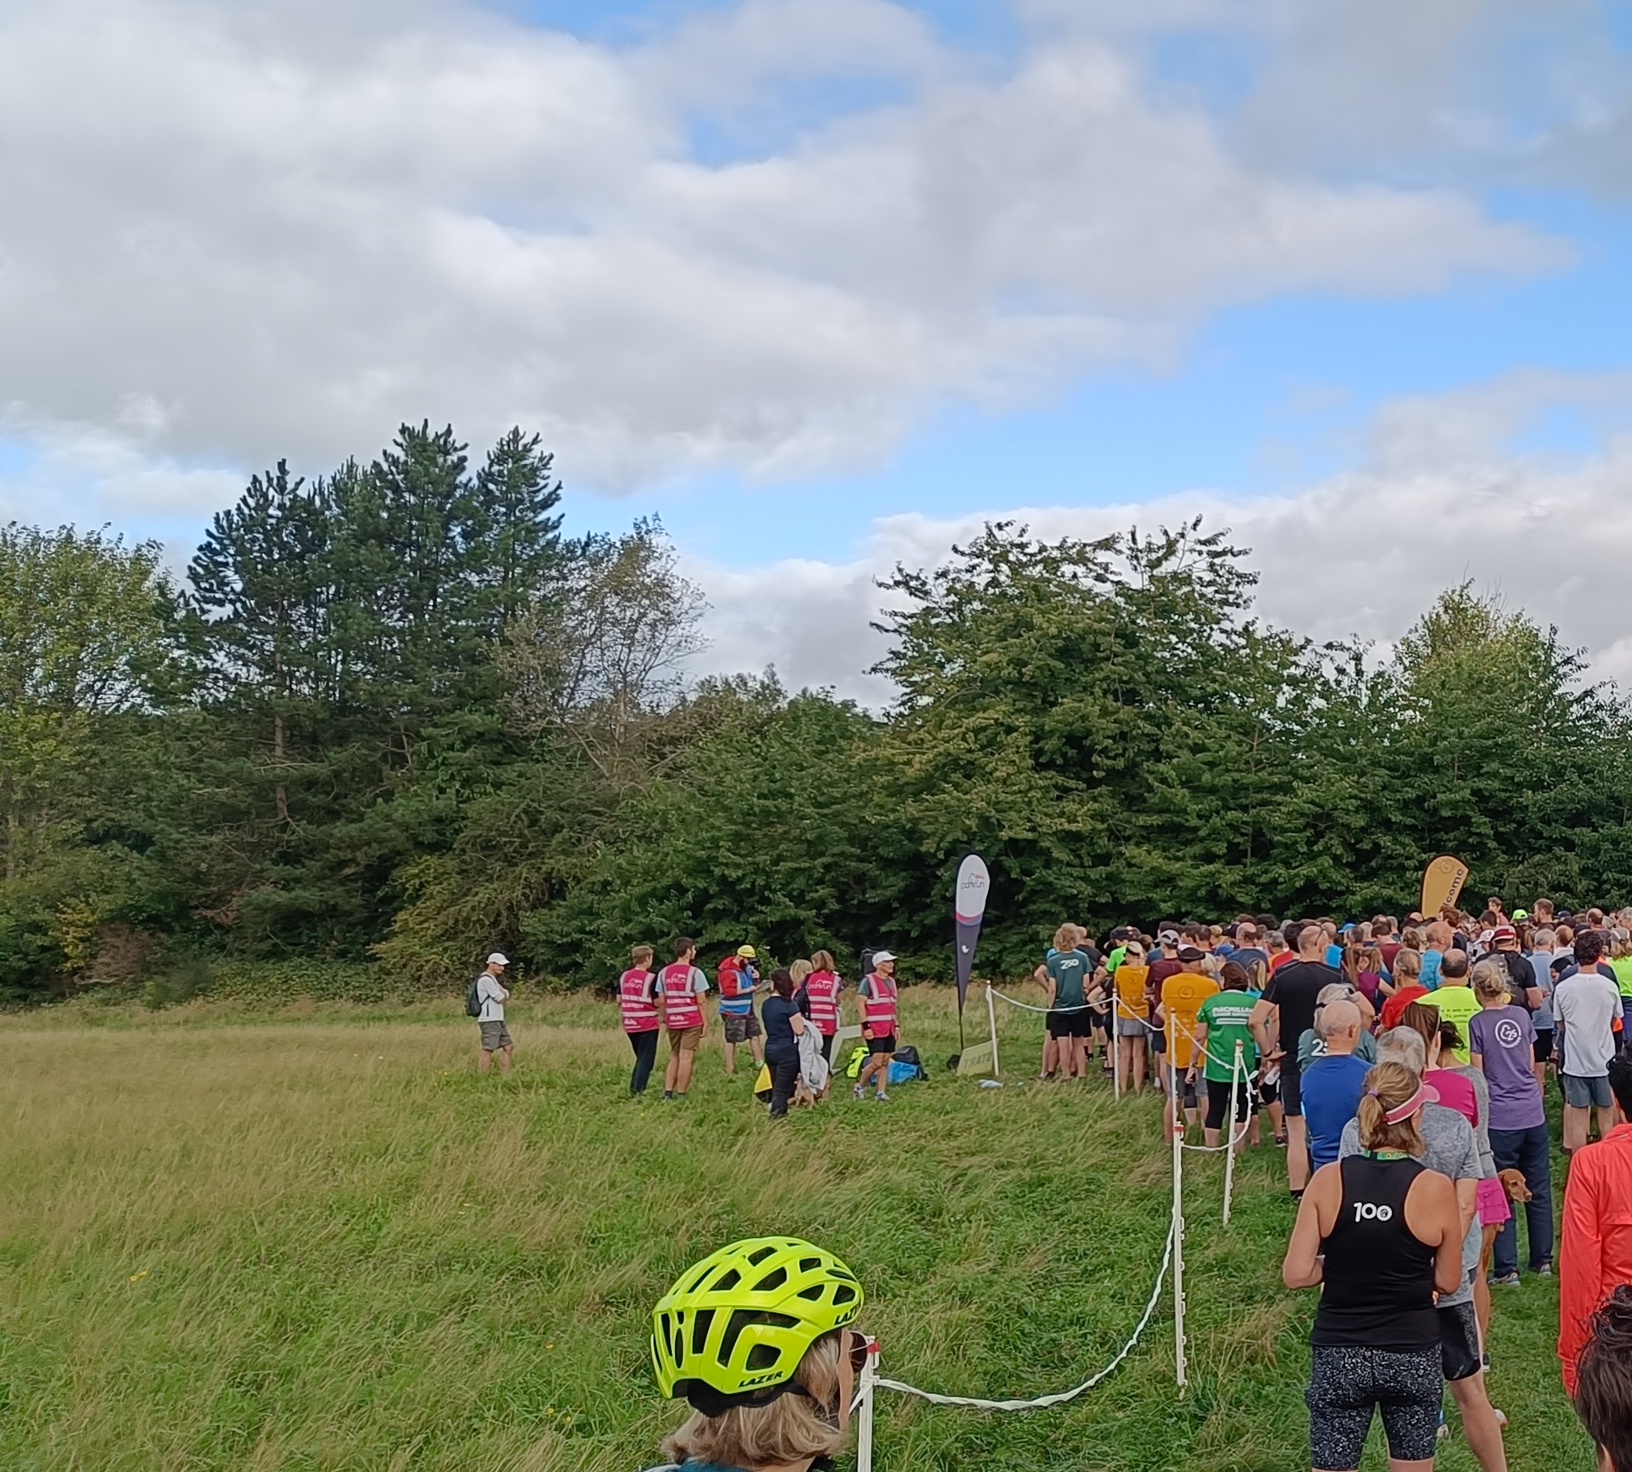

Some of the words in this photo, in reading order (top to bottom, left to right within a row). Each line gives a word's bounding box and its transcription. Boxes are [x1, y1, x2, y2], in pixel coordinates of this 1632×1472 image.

[1442, 868, 1464, 906] lcome
[1060, 958, 1079, 970] 250
[1353, 1201, 1393, 1223] 100
[738, 1370, 784, 1388] LAZER
